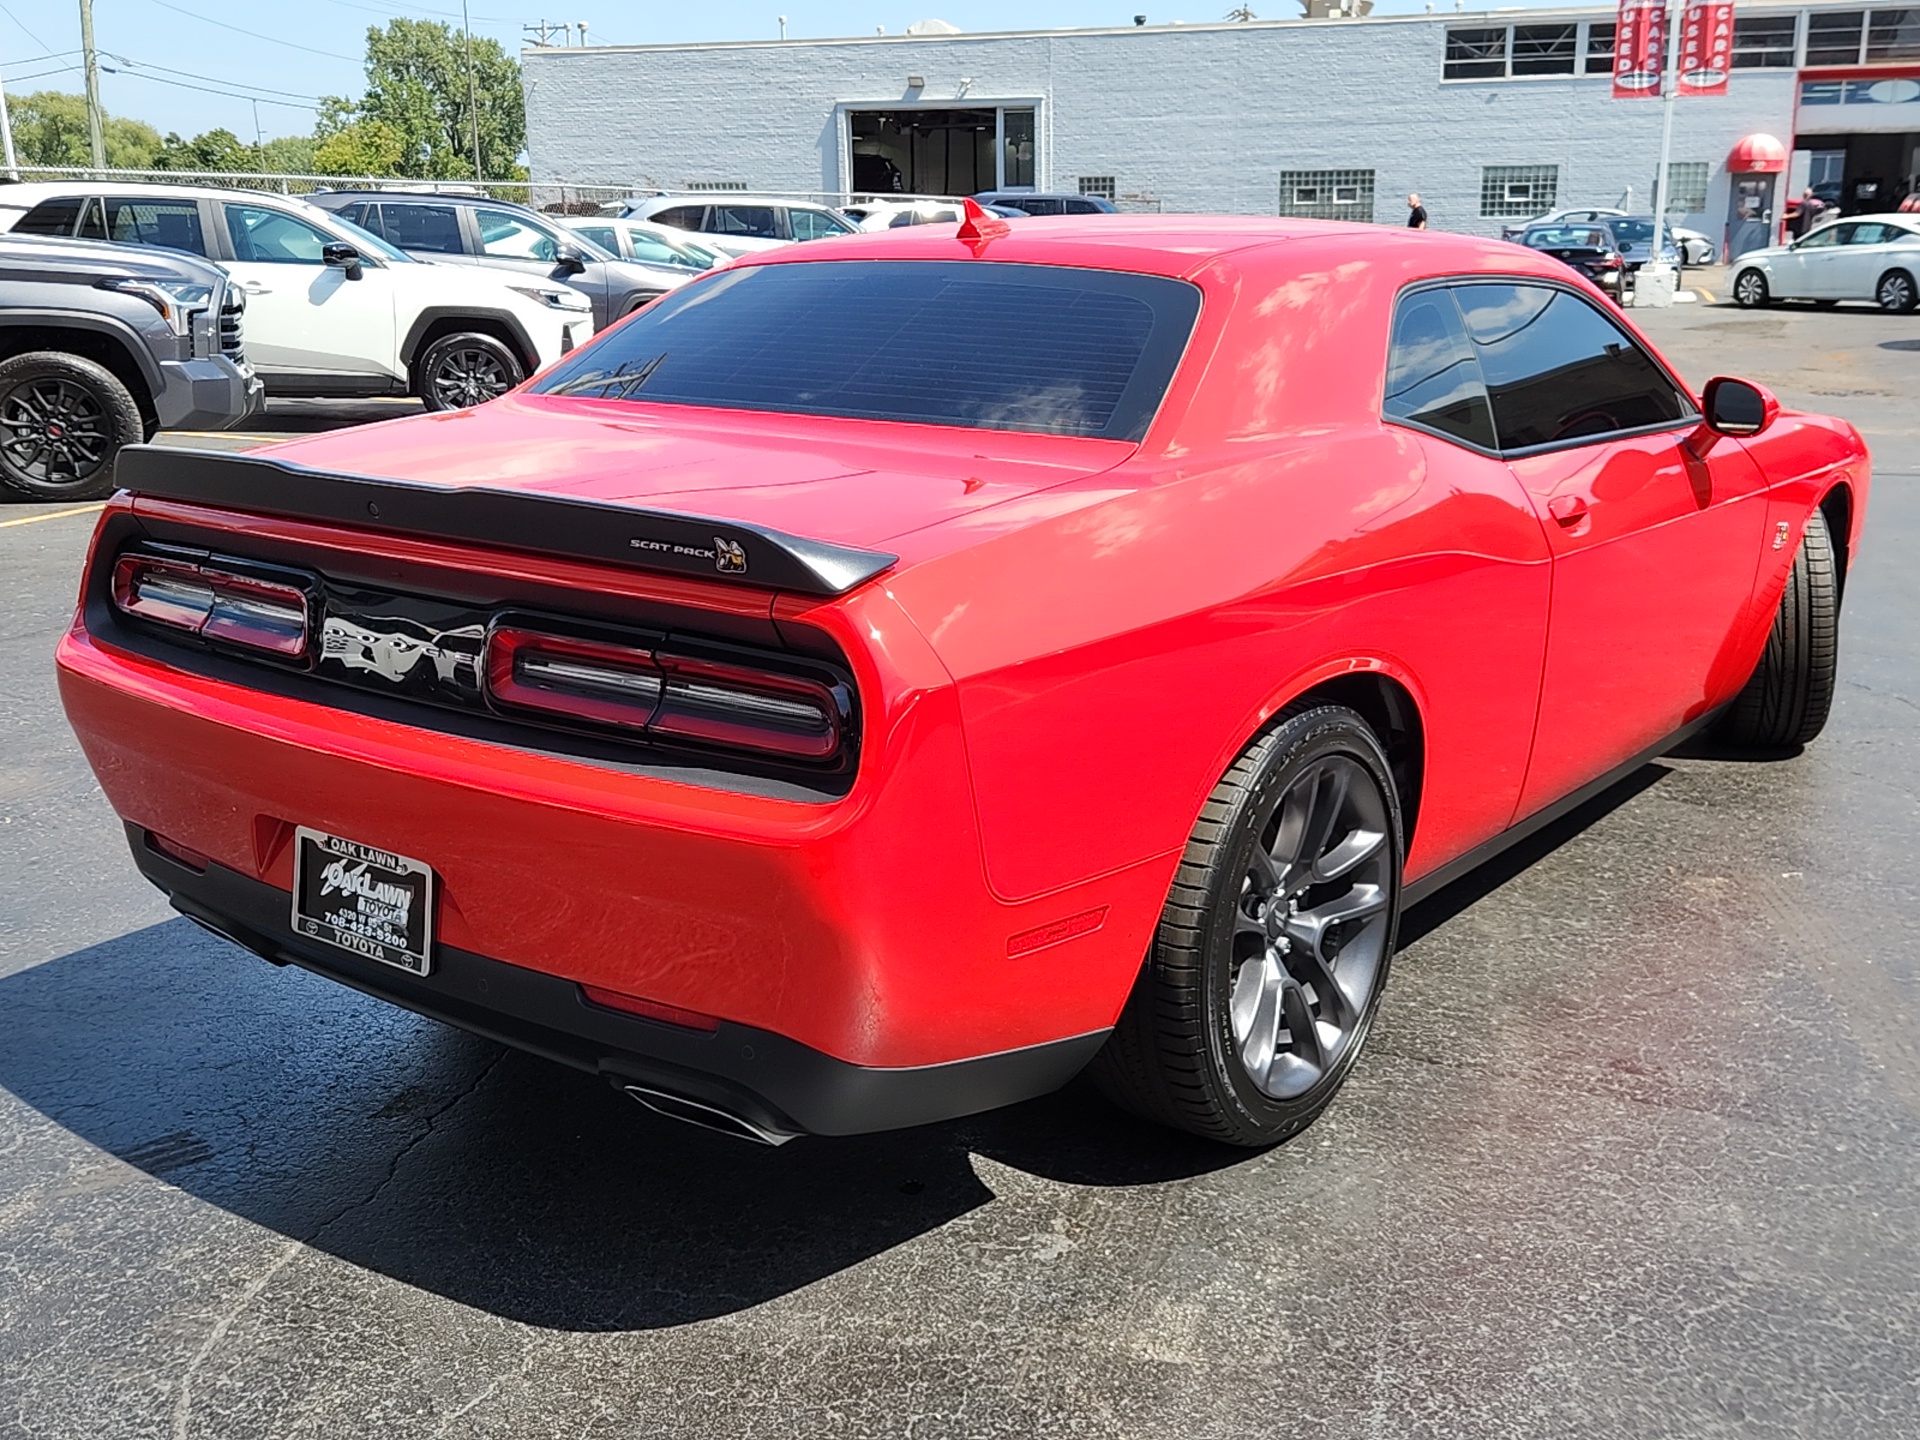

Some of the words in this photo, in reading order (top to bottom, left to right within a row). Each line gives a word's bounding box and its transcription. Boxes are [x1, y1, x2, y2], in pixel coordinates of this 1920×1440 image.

[1618, 10, 1636, 71] USED
[1647, 10, 1662, 70] CARS
[1684, 8, 1701, 69] USED
[1712, 6, 1731, 69] CARS
[629, 539, 671, 552] SCAT
[673, 545, 716, 559] PACK
[331, 838, 357, 857] OAK
[360, 847, 397, 868] LAWN
[362, 899, 403, 922] TOYOTA
[324, 911, 408, 949] 708-423-5200
[334, 929, 385, 959] TOYOTA
